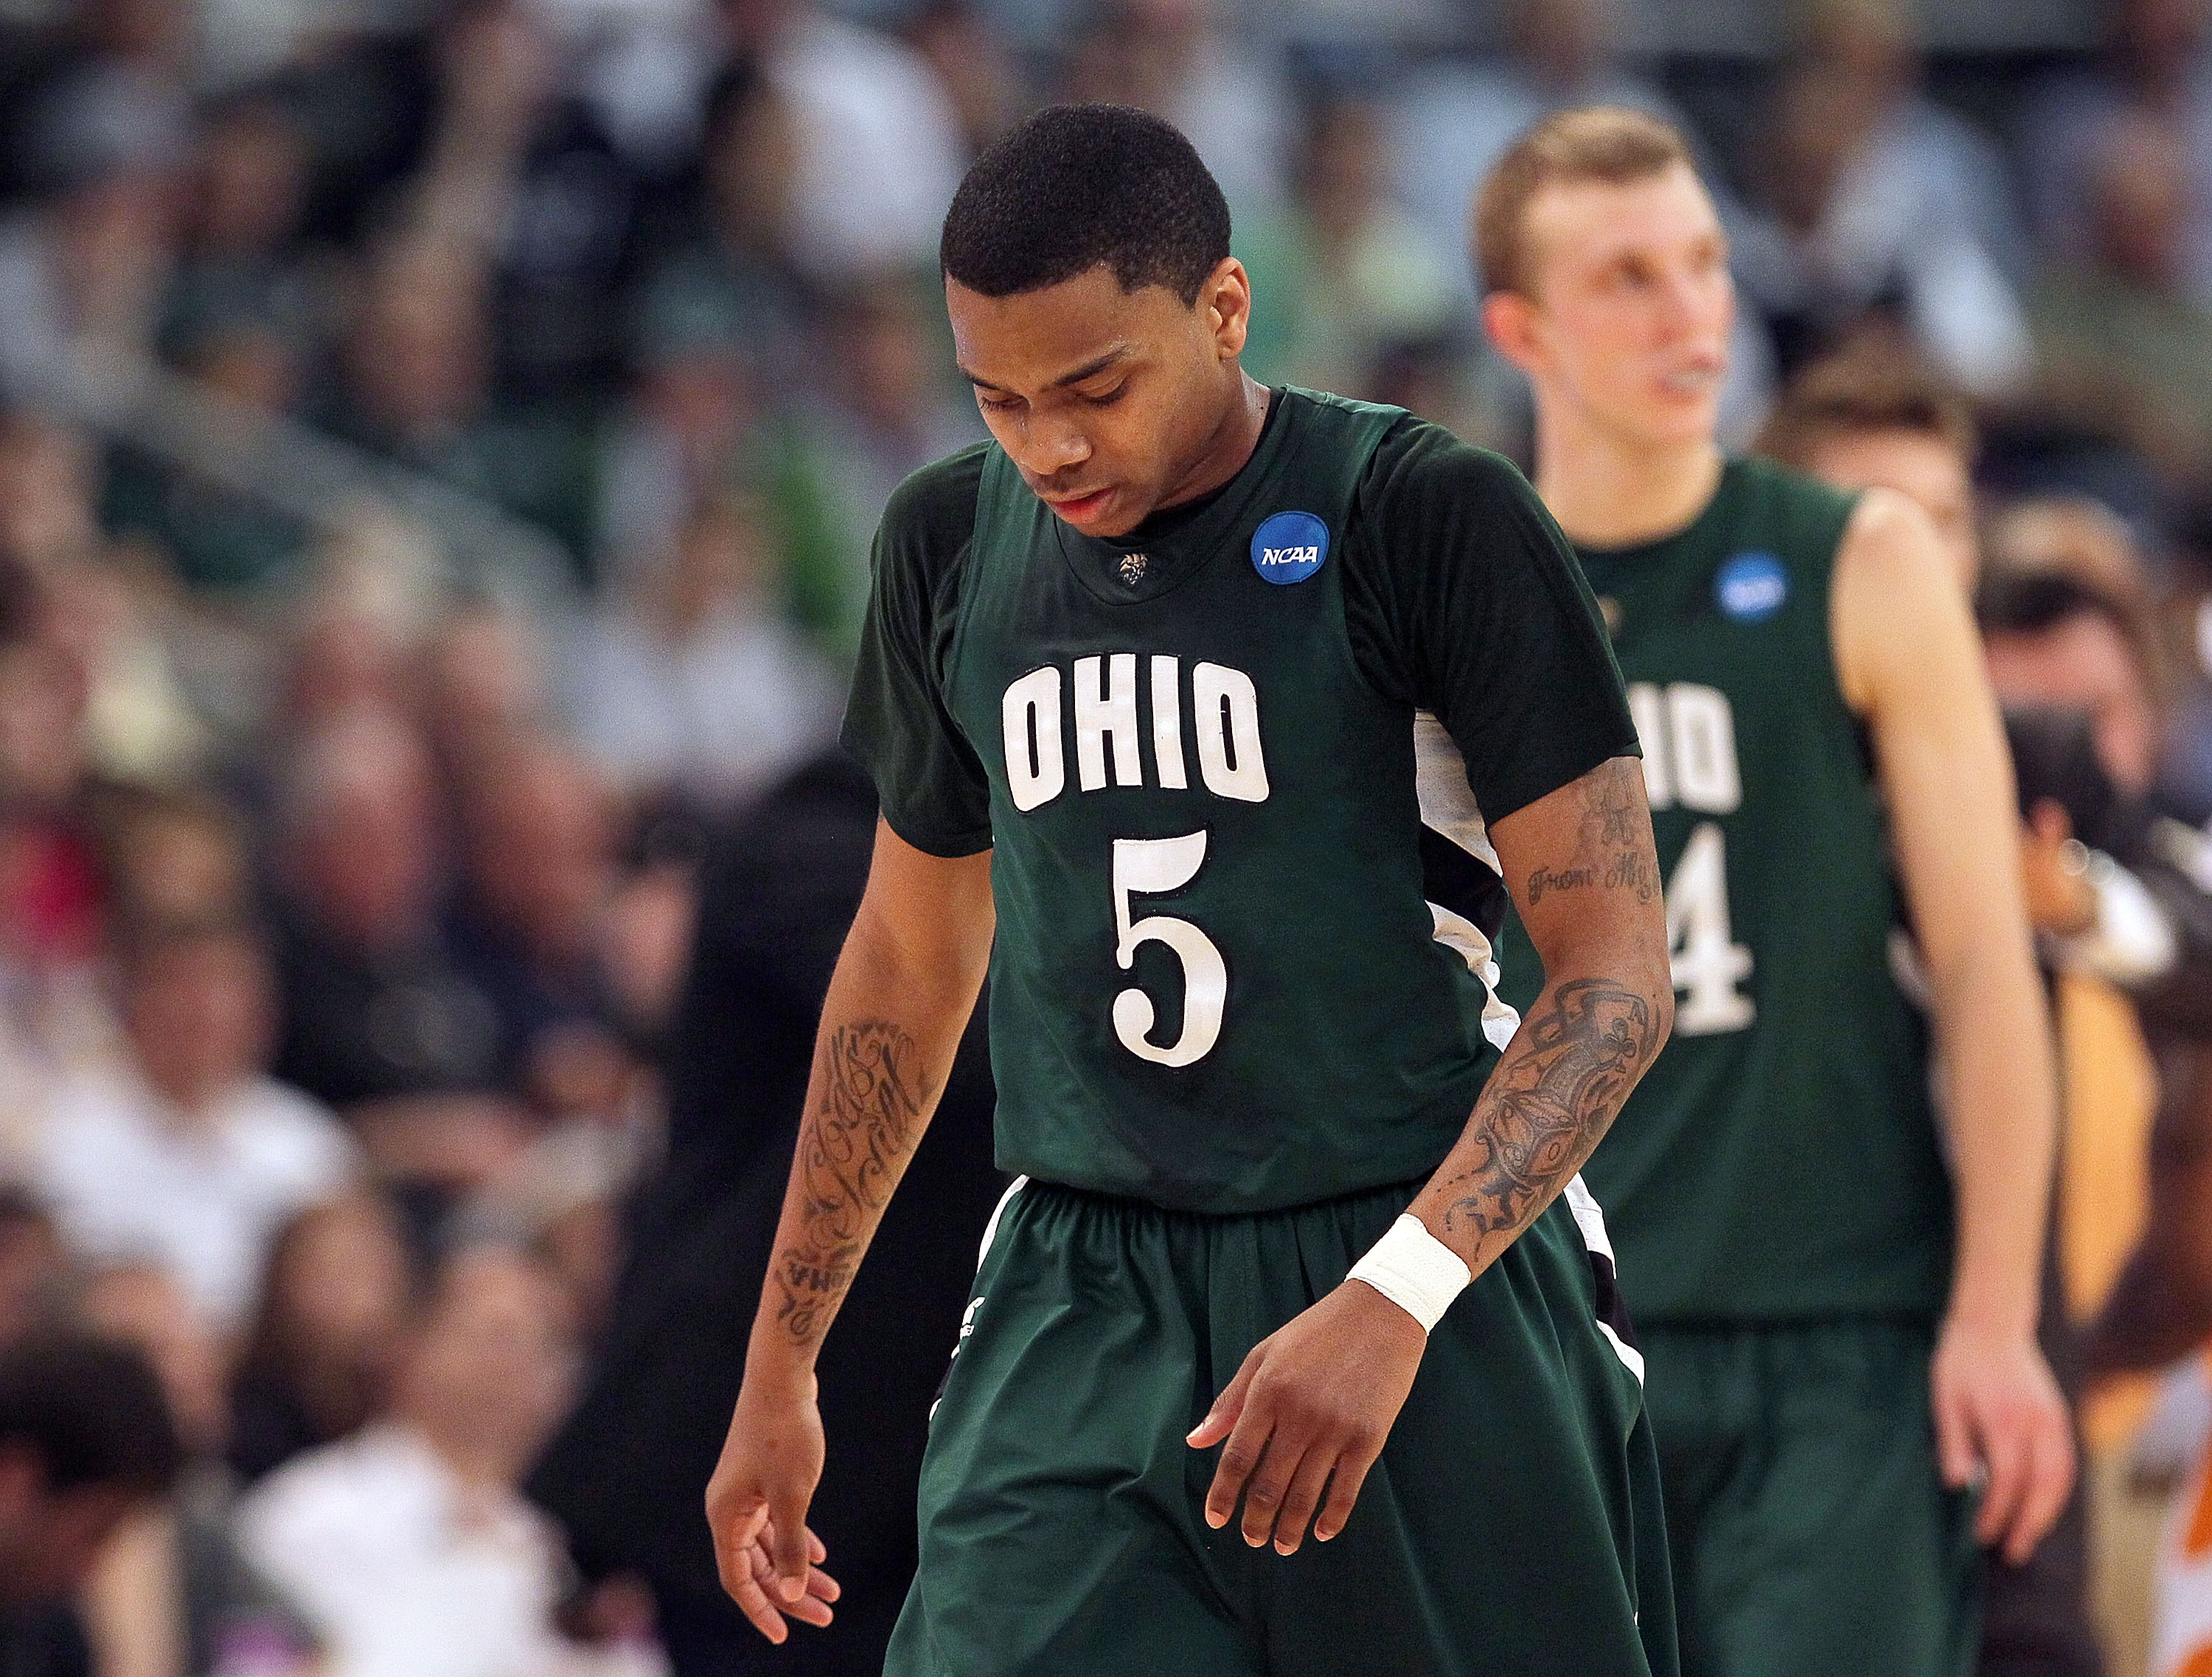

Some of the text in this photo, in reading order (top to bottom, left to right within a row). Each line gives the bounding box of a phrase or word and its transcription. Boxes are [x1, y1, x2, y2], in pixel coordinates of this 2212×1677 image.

[1262, 546, 1318, 565] NCAA
[1002, 653, 1270, 812] OHIO
[1112, 829, 1227, 1068] 5
